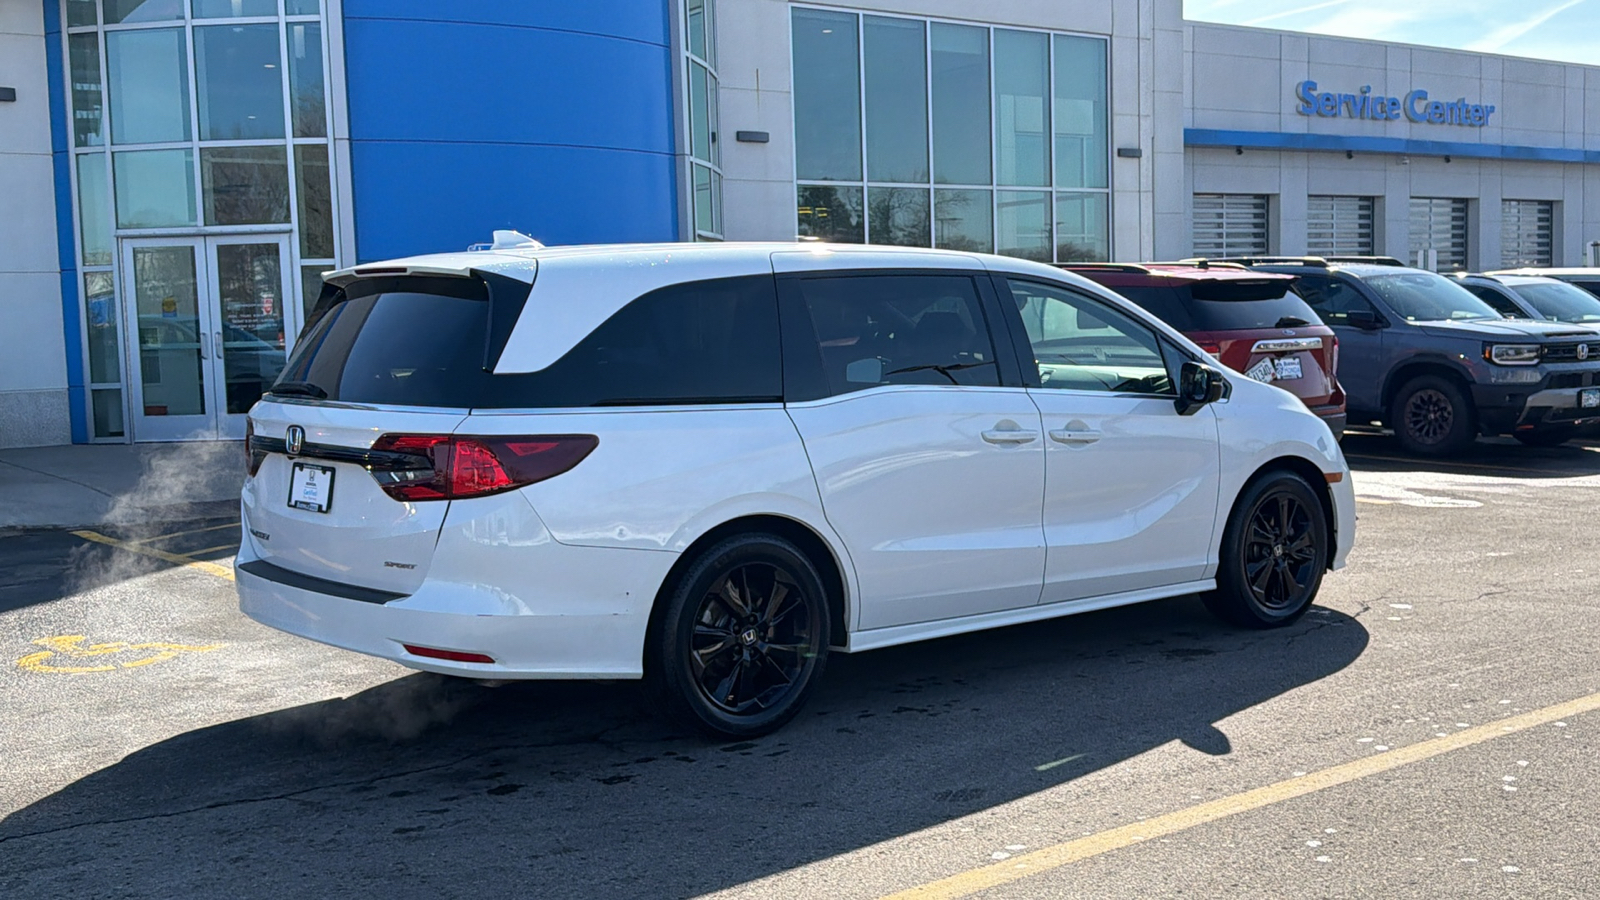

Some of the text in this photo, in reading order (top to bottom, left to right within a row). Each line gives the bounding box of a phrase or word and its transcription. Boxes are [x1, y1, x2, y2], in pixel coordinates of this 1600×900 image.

[1296, 80, 1496, 127] Service Center
[384, 561, 418, 570] SPORT
